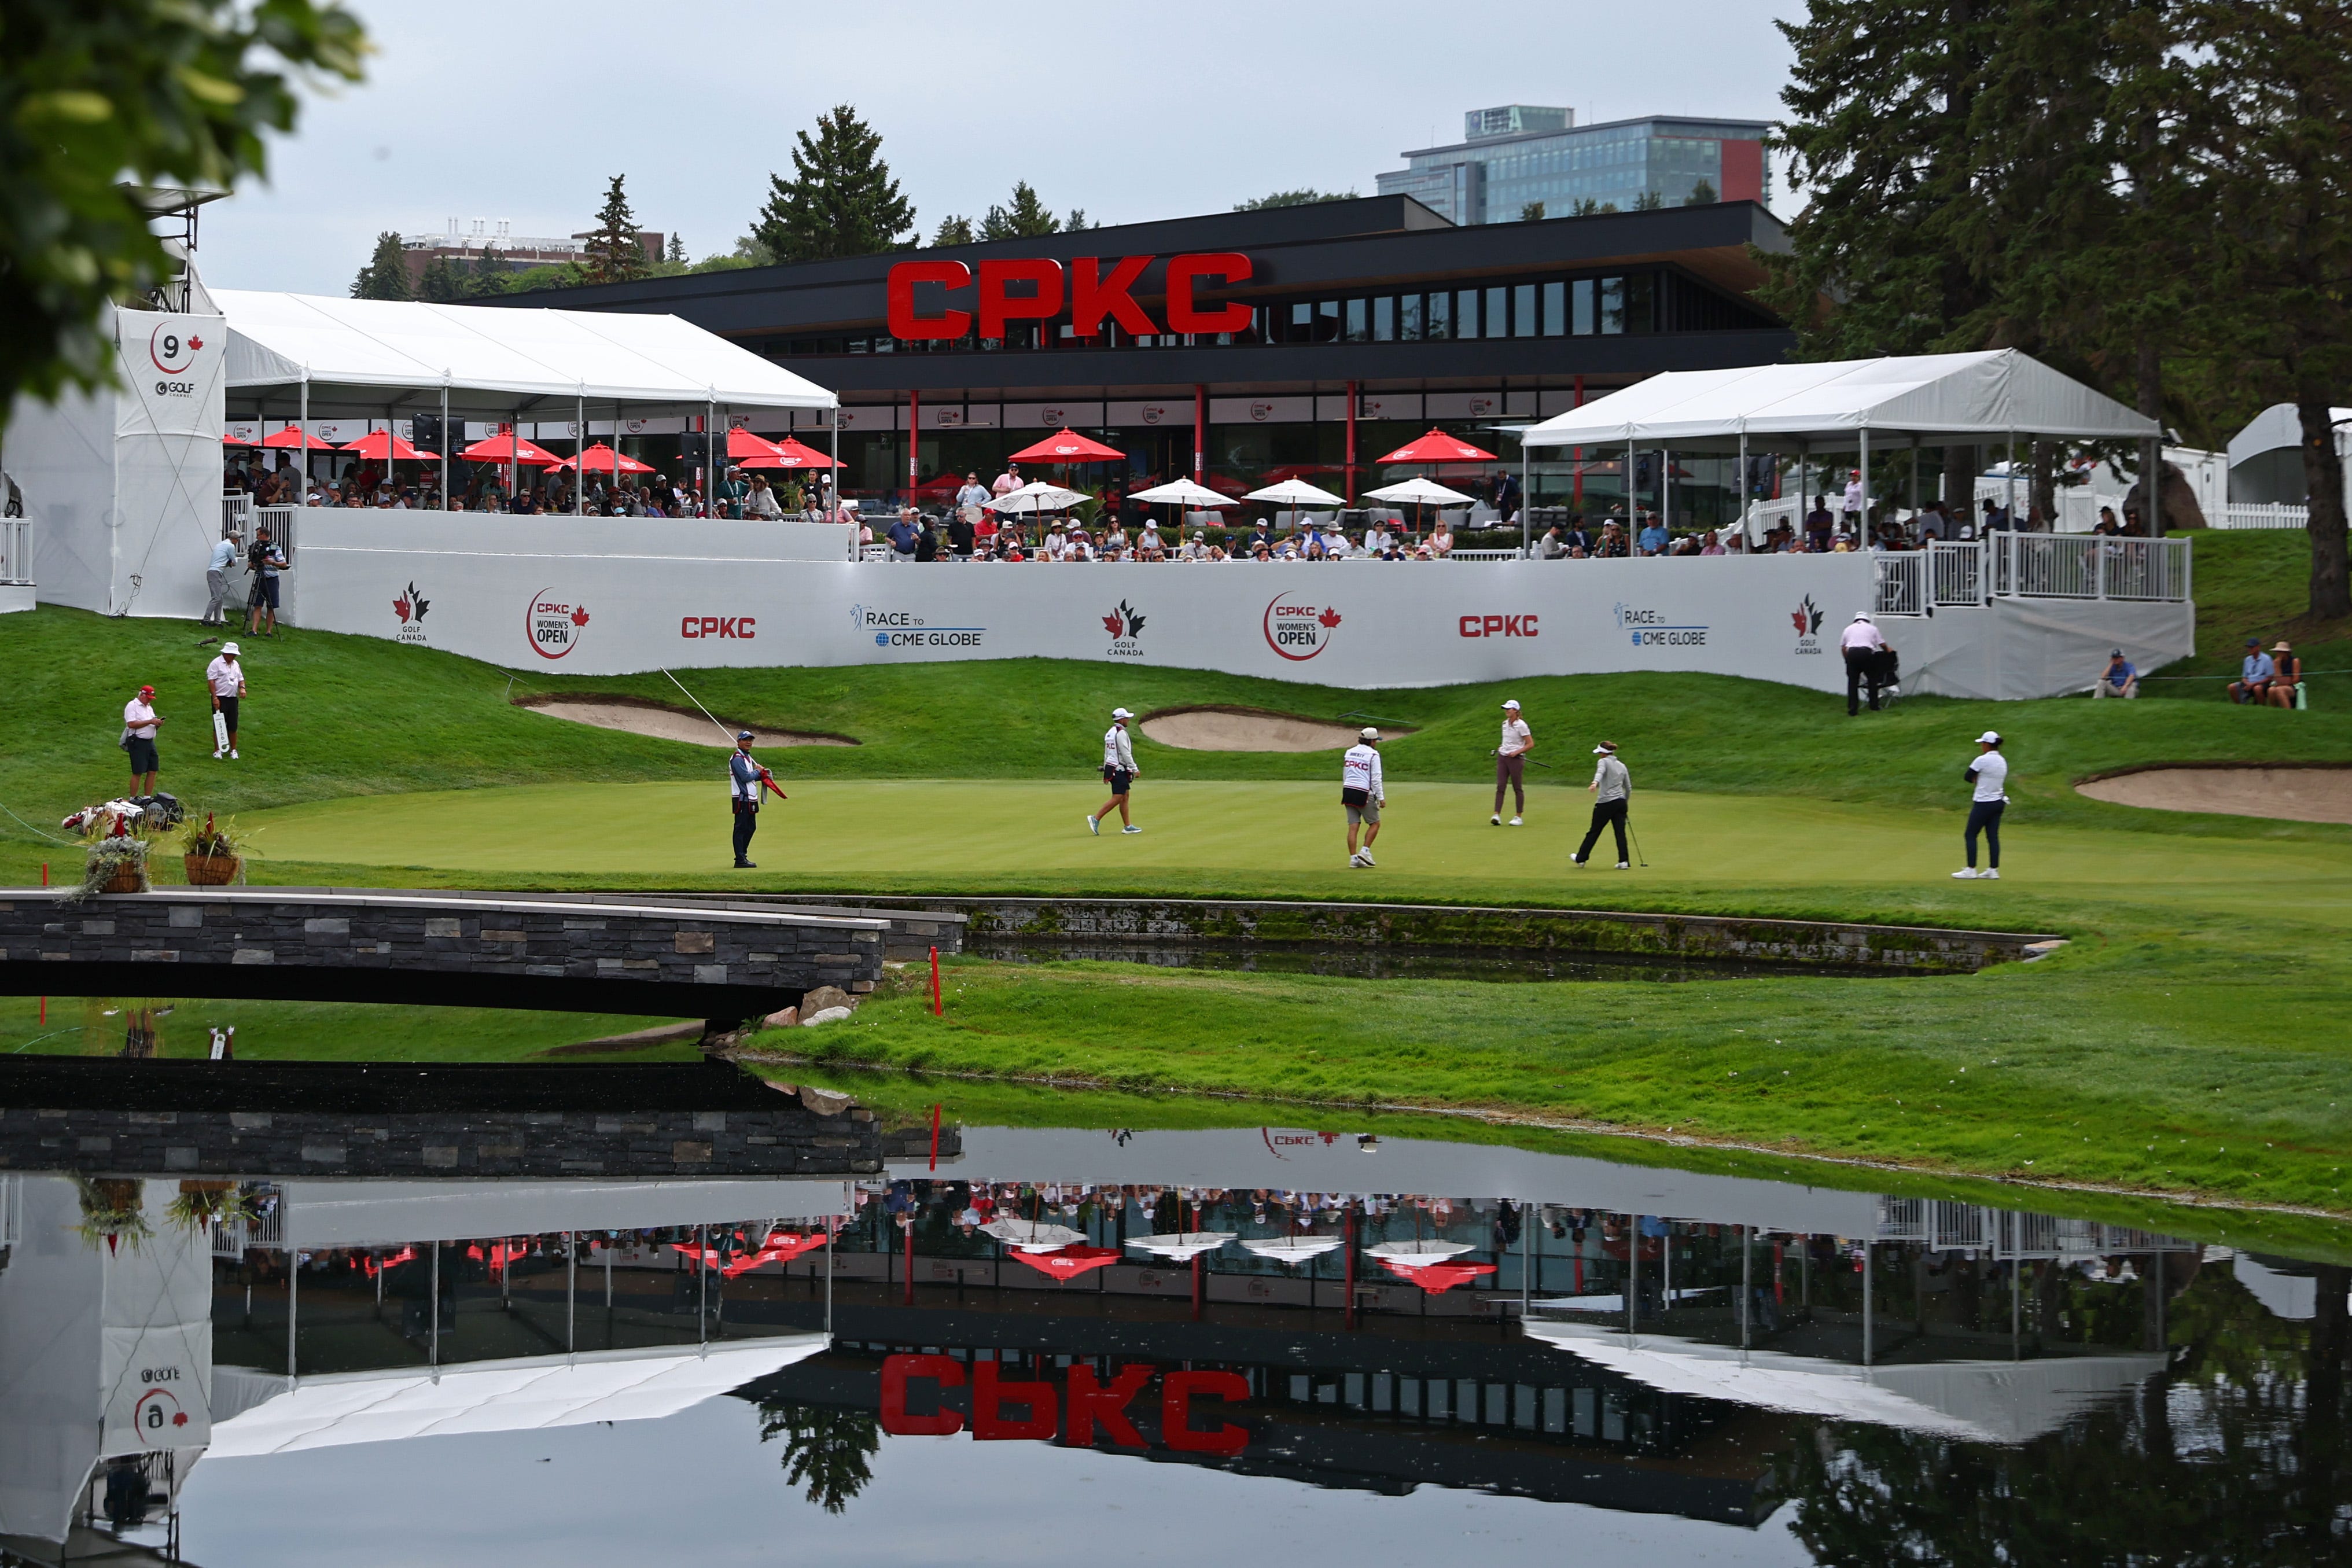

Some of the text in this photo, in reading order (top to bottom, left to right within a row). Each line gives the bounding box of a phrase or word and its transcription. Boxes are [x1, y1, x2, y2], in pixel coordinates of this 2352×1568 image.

[888, 252, 1253, 340] CPKC
[164, 335, 179, 359] 9
[168, 382, 194, 393] GOLF
[537, 603, 569, 614] CPKC
[1276, 606, 1316, 616] CPKC
[866, 612, 910, 625] RACE
[1625, 610, 1655, 624] RACE
[537, 620, 568, 629] WOMEN'S
[682, 617, 756, 638] CPKC
[1277, 623, 1316, 631] WOMEN'S
[1460, 615, 1538, 637] CPKC
[537, 629, 568, 643] OPEN
[892, 634, 981, 646] CME GLOBE
[1278, 631, 1316, 645] OPEN
[1643, 632, 1706, 645] CME GLOBE
[1344, 760, 1369, 771] CPKC
